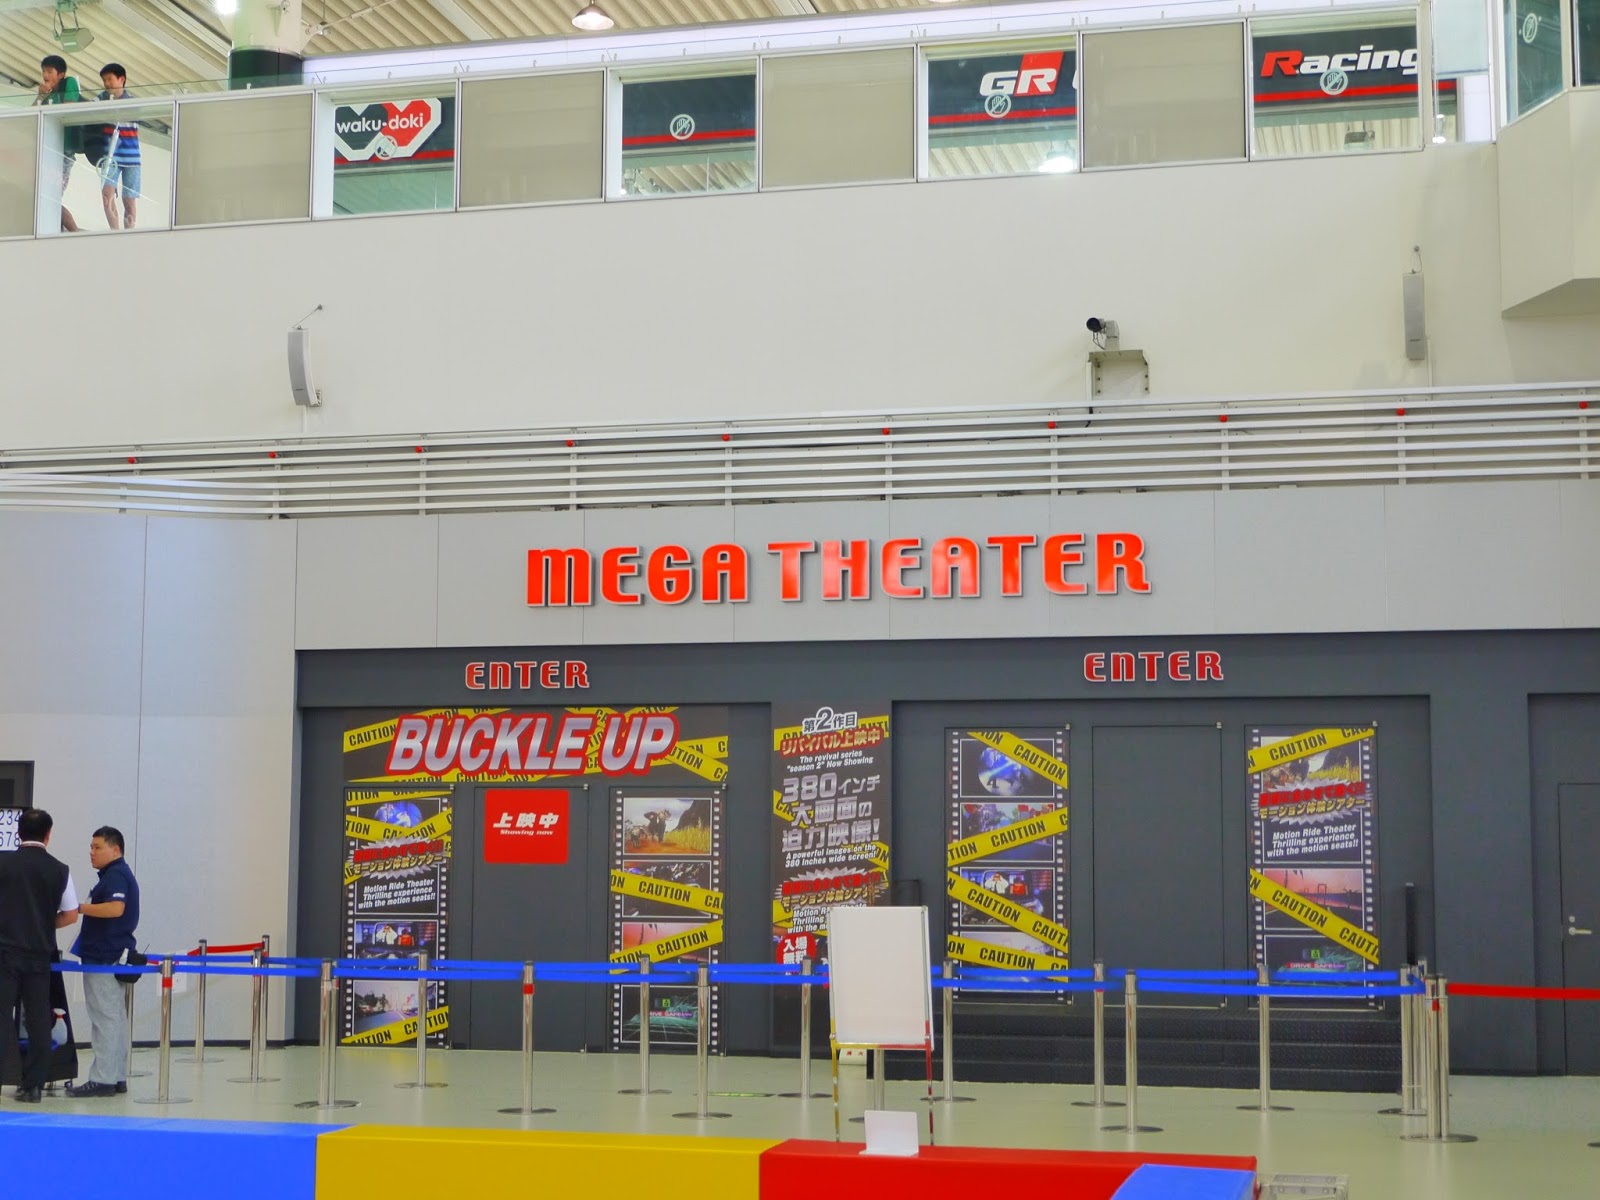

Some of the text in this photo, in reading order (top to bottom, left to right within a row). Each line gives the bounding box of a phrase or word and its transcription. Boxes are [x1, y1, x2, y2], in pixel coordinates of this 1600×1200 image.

[1260, 44, 1418, 77] Racing
[979, 67, 1057, 96] GR
[526, 531, 1152, 608] MEGA THEATER
[465, 660, 590, 690] ENTER
[1083, 650, 1224, 683] ENTER
[802, 707, 858, 734] 第2作目
[387, 714, 678, 774] BUCKLE UP
[781, 728, 881, 756] リバイバル上映中
[1269, 733, 1328, 761] CAUTION
[800, 750, 863, 764] The revival series
[826, 760, 842, 769] Now
[844, 756, 874, 767] Showing
[1013, 744, 1067, 781] CAUTION
[791, 796, 872, 827] 大画面の
[1259, 797, 1366, 819] モーション体験シアター
[492, 812, 559, 829] 上映中
[1272, 823, 1357, 840] Motion Ride Theater
[500, 829, 535, 837] Showing
[990, 820, 1046, 847] CAUTION
[1272, 832, 1355, 849] Thrilling experience
[793, 848, 824, 860] powerful
[802, 857, 826, 866] inches
[829, 855, 846, 863] wide
[1266, 848, 1284, 858] with
[1286, 846, 1299, 855] the
[1301, 843, 1328, 854] motion
[353, 853, 443, 875] モーション体験シアター
[363, 878, 435, 894] Motion Ride Theater
[363, 886, 433, 902] Thrilling experience
[638, 880, 691, 902] CAUTION
[358, 901, 373, 910] with
[375, 898, 386, 907] the
[387, 896, 410, 906] motion
[793, 908, 818, 918] Motion
[967, 888, 1021, 922] CAUTION
[1271, 889, 1328, 928] CAUTION
[787, 925, 803, 934] with
[805, 923, 818, 932] the
[792, 915, 824, 926] Thrilling
[656, 930, 709, 955] CAUTION
[980, 947, 1036, 970] CAUTION
